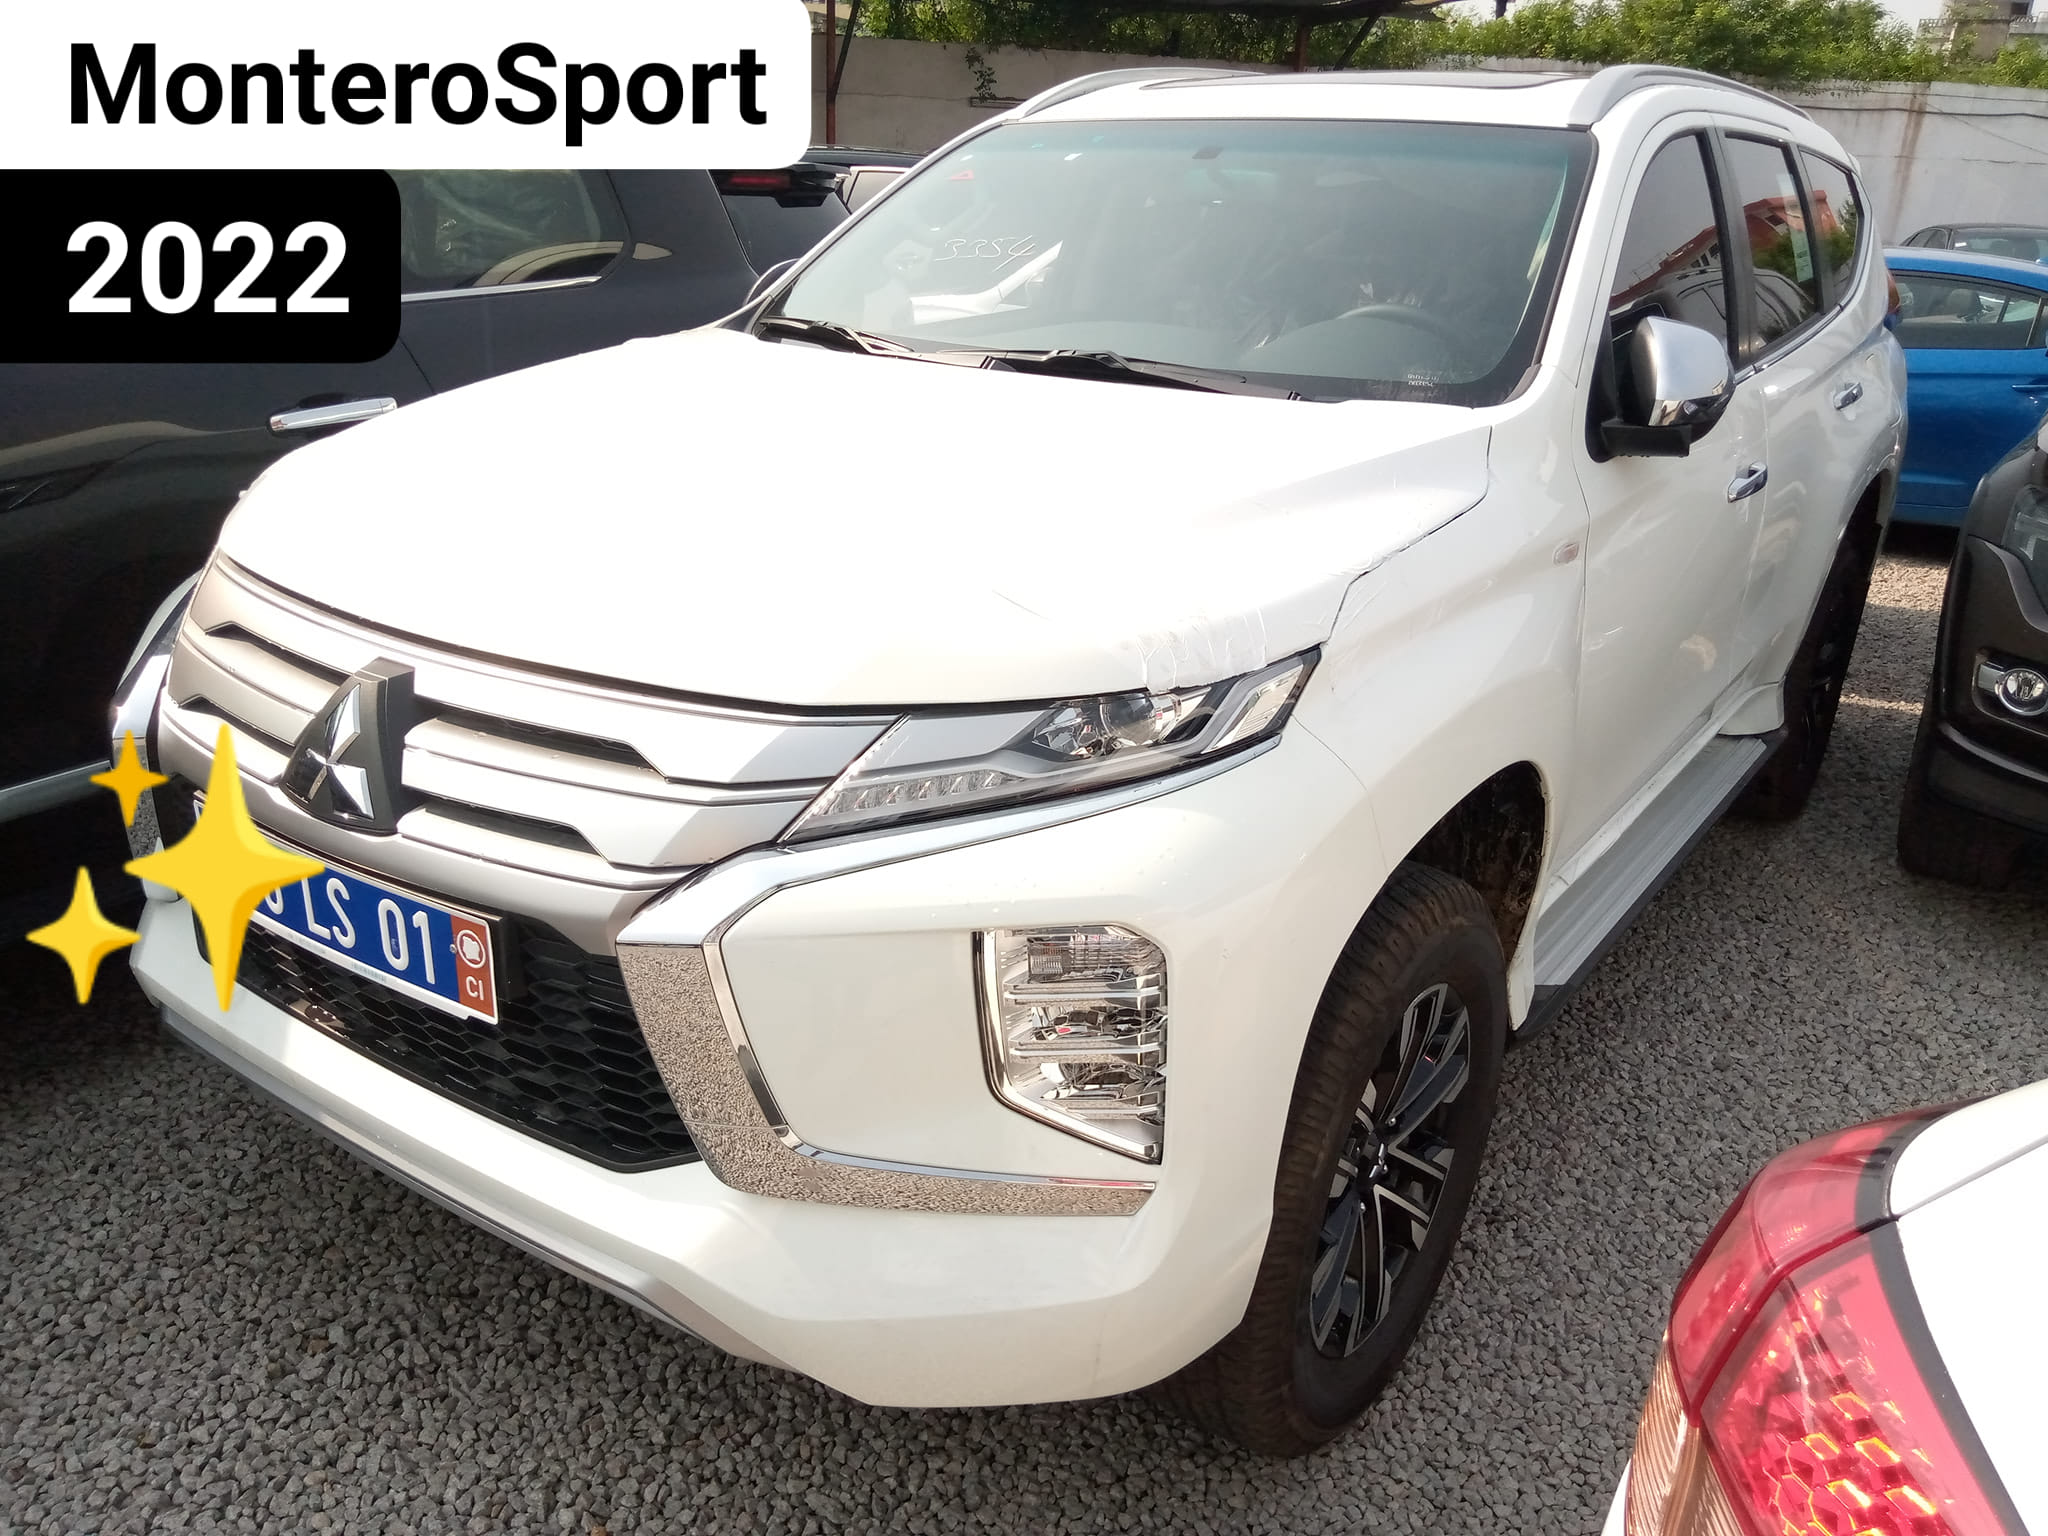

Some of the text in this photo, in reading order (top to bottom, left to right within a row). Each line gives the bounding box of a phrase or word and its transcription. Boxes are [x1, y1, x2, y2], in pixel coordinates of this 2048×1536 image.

[301, 876, 435, 985] LS 01
[466, 975, 484, 1001] CI
